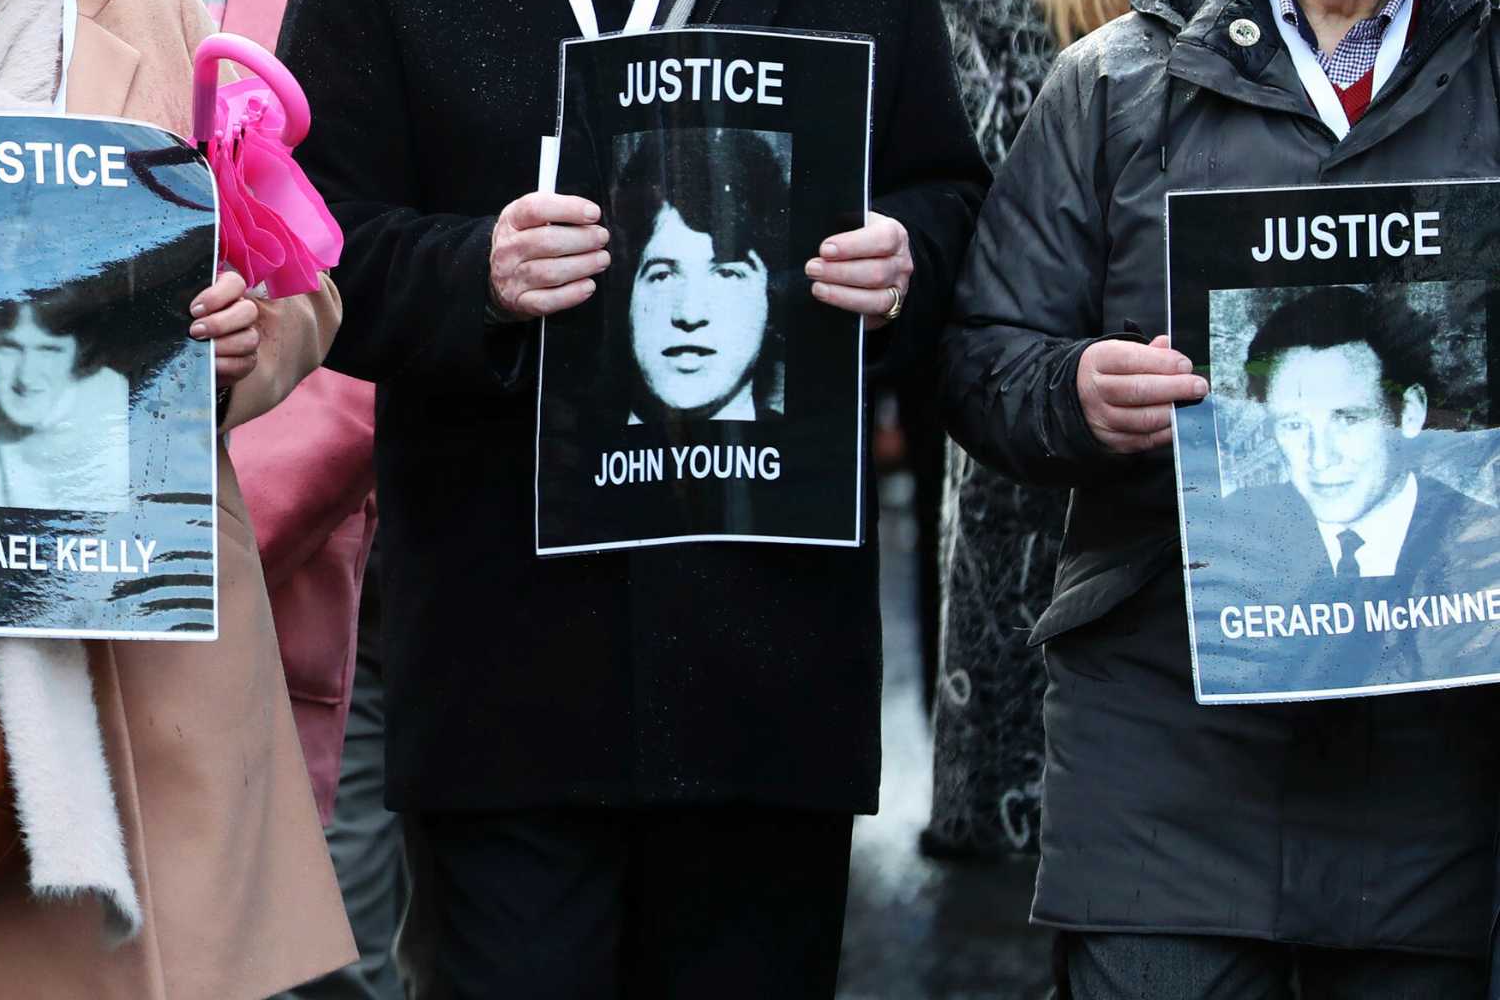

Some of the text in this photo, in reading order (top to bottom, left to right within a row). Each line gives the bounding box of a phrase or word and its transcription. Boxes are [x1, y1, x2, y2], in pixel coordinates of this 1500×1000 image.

[619, 58, 784, 107] JUSTICE
[1251, 211, 1442, 262] JUSTICE
[594, 445, 781, 487] JOHN YOUNG
[57, 537, 157, 574] KELLY
[1220, 602, 1355, 639] GERARD
